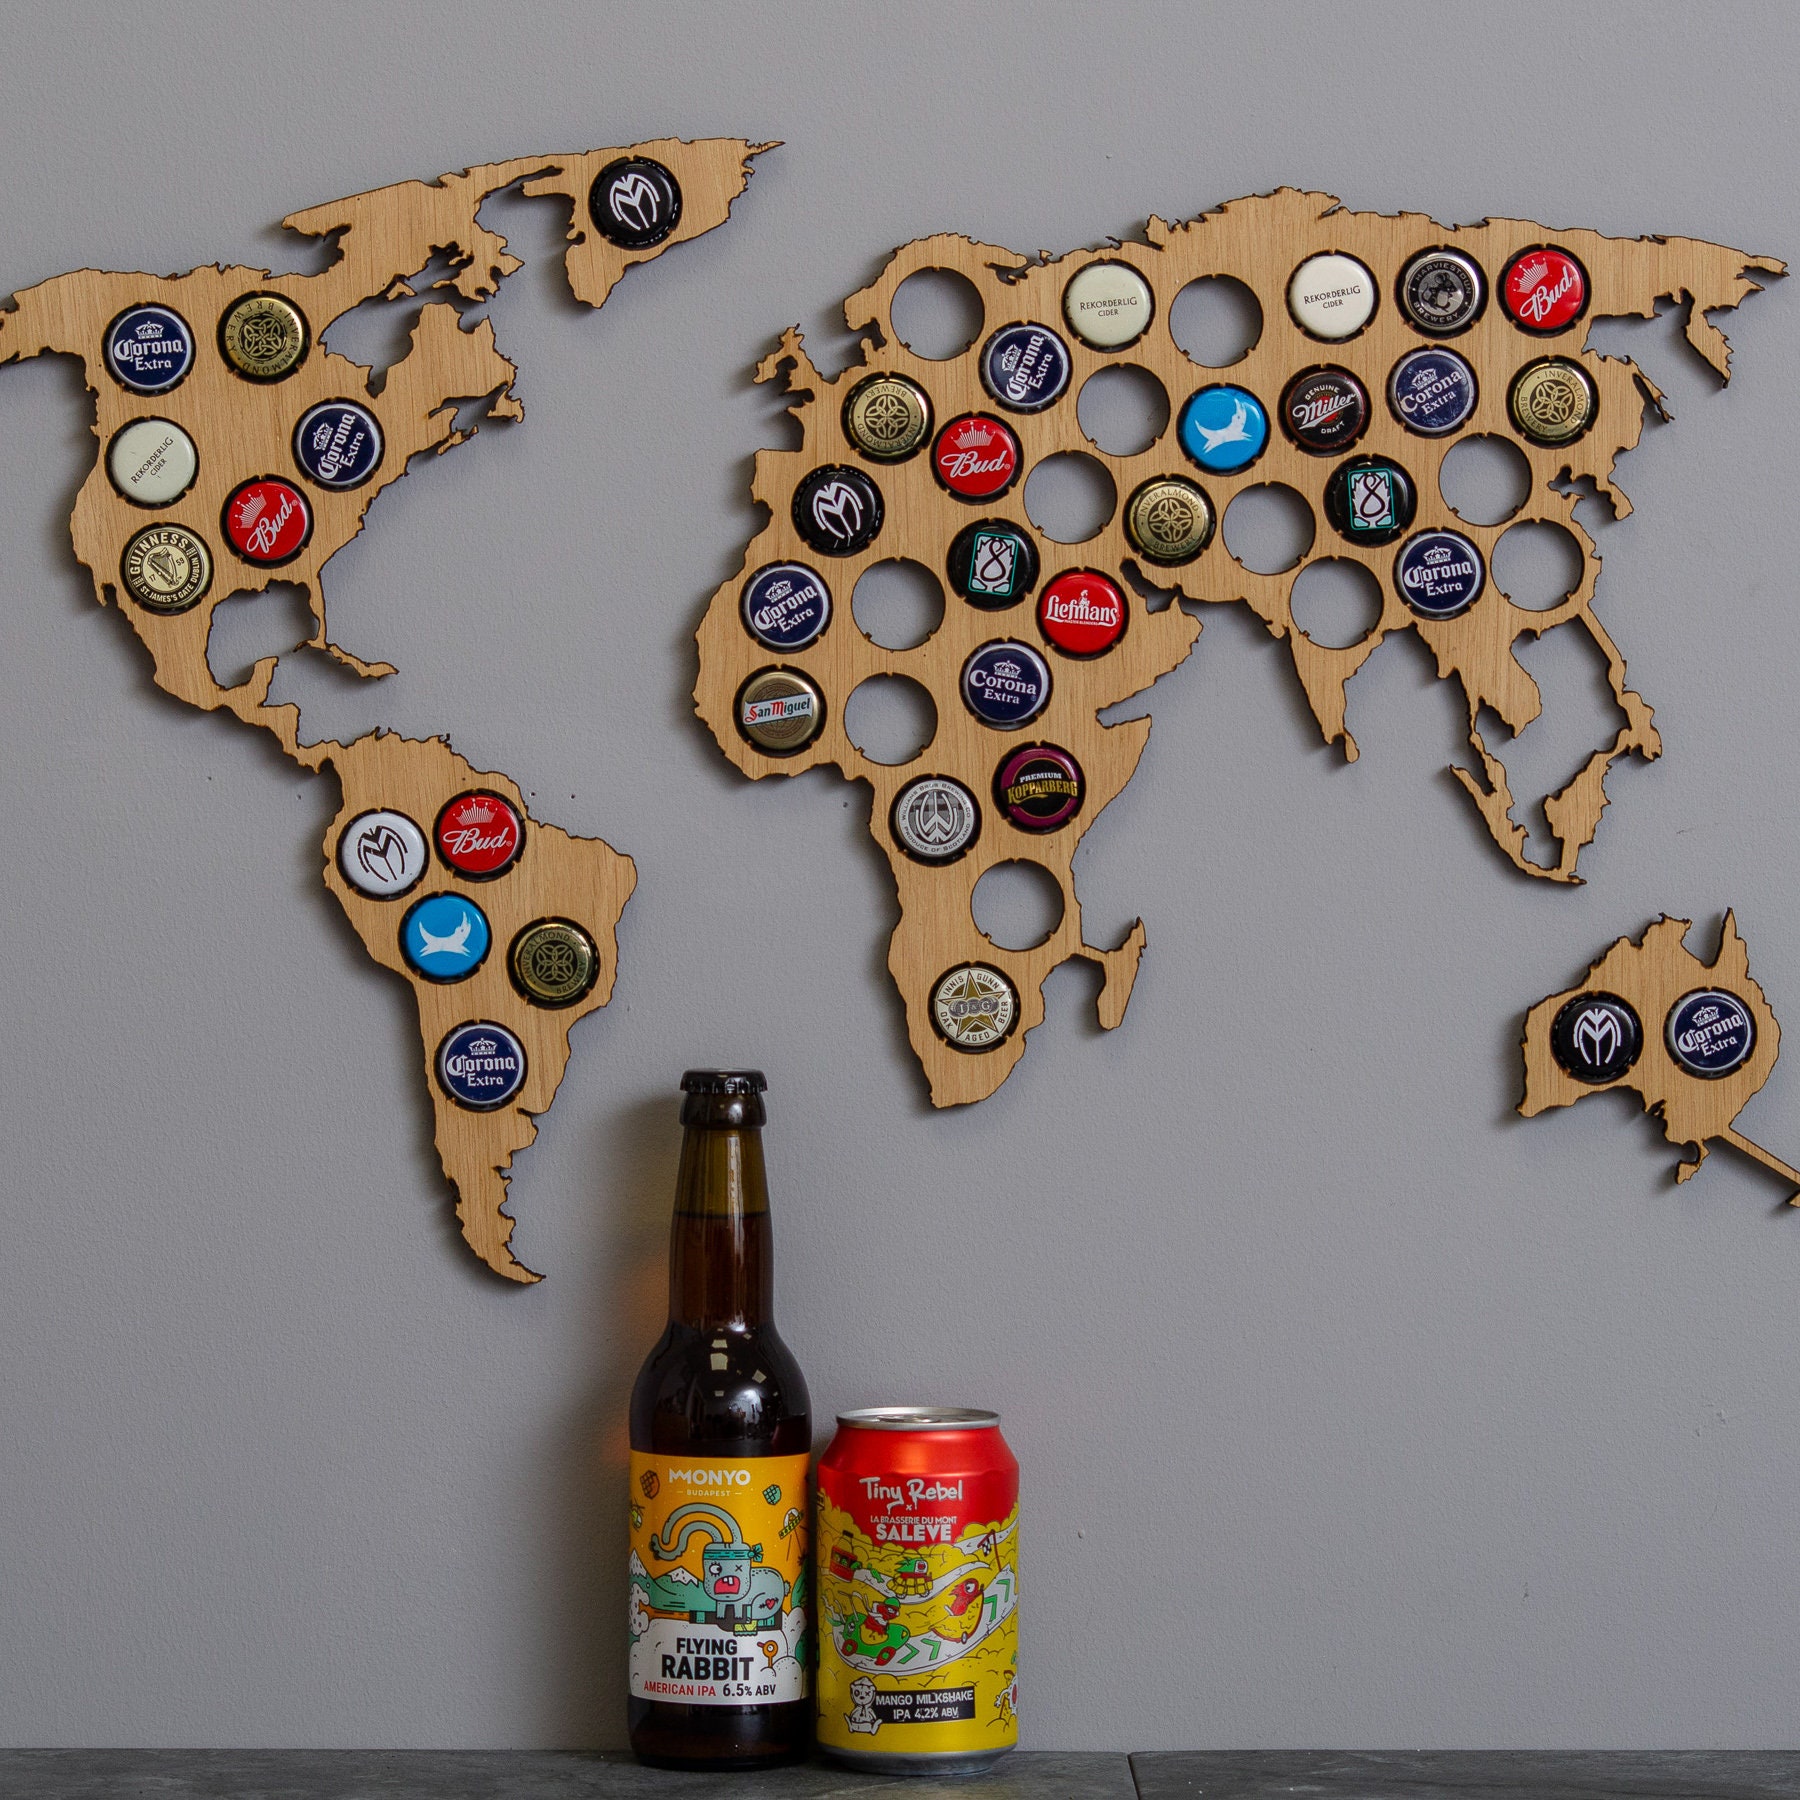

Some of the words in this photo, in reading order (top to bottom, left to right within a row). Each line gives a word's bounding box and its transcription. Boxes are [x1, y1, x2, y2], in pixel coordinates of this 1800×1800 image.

[1080, 297, 1137, 310] REKORDERLIG
[1304, 285, 1361, 305] REKORDERLIG
[1323, 299, 1344, 309] CIDER
[1098, 308, 1119, 317] CIDER
[1413, 301, 1458, 322] BREWERY
[114, 339, 183, 361] Corona
[135, 358, 172, 370] Extra
[1006, 335, 1045, 401] Corona
[1030, 354, 1053, 389] Extra
[1305, 384, 1339, 400] GENUINE
[1400, 370, 1461, 413] Corona
[1421, 390, 1457, 414] Extra
[1292, 391, 1356, 425] Miller
[1321, 420, 1345, 434] DRAFT
[318, 413, 356, 479] Corona
[341, 432, 365, 467] Extra
[131, 437, 174, 484] REKORDERLIG
[150, 458, 167, 476] CIDER
[130, 532, 189, 575] GUINNESS
[178, 583, 194, 598] GATE
[190, 557, 200, 583] DUBLIN
[1404, 561, 1473, 588] Corona
[1426, 582, 1463, 597] Extra
[754, 584, 818, 630] Corona
[1045, 595, 1118, 627] Liefmans
[779, 608, 815, 632] Extra
[969, 669, 1037, 695] Corona
[984, 689, 1020, 705] Extra
[1020, 772, 1062, 782] PREMIUM
[1007, 780, 1078, 805] KOPPARBERG
[943, 976, 964, 996] INNIS
[976, 974, 1000, 990] GUNN
[940, 1012, 953, 1030] OAK
[965, 1032, 990, 1042] AGED
[998, 1002, 1008, 1024] BEER
[1678, 1014, 1743, 1053] Corona
[1701, 1035, 1738, 1056] Extra
[446, 1055, 516, 1077] Corona
[467, 1074, 503, 1087] Extra
[859, 1476, 904, 1515] Tiny
[907, 1478, 962, 1510] Rebel
[880, 1516, 920, 1524] BRASSERIE
[922, 1516, 934, 1524] DU
[936, 1516, 957, 1524] MONT
[676, 1638, 738, 1656] FLYING
[662, 1654, 754, 1680] RABBIT
[644, 1681, 694, 1696] AMERICAN
[698, 1686, 716, 1696] IPA
[722, 1683, 752, 1696] 6.5%
[755, 1684, 776, 1696] ABV
[876, 1694, 912, 1706] MANGO
[916, 1690, 974, 1705] MILKSHAKE
[893, 1709, 910, 1720] IPA
[914, 1708, 938, 1719] 4.2%
[942, 1707, 958, 1718] ABV
